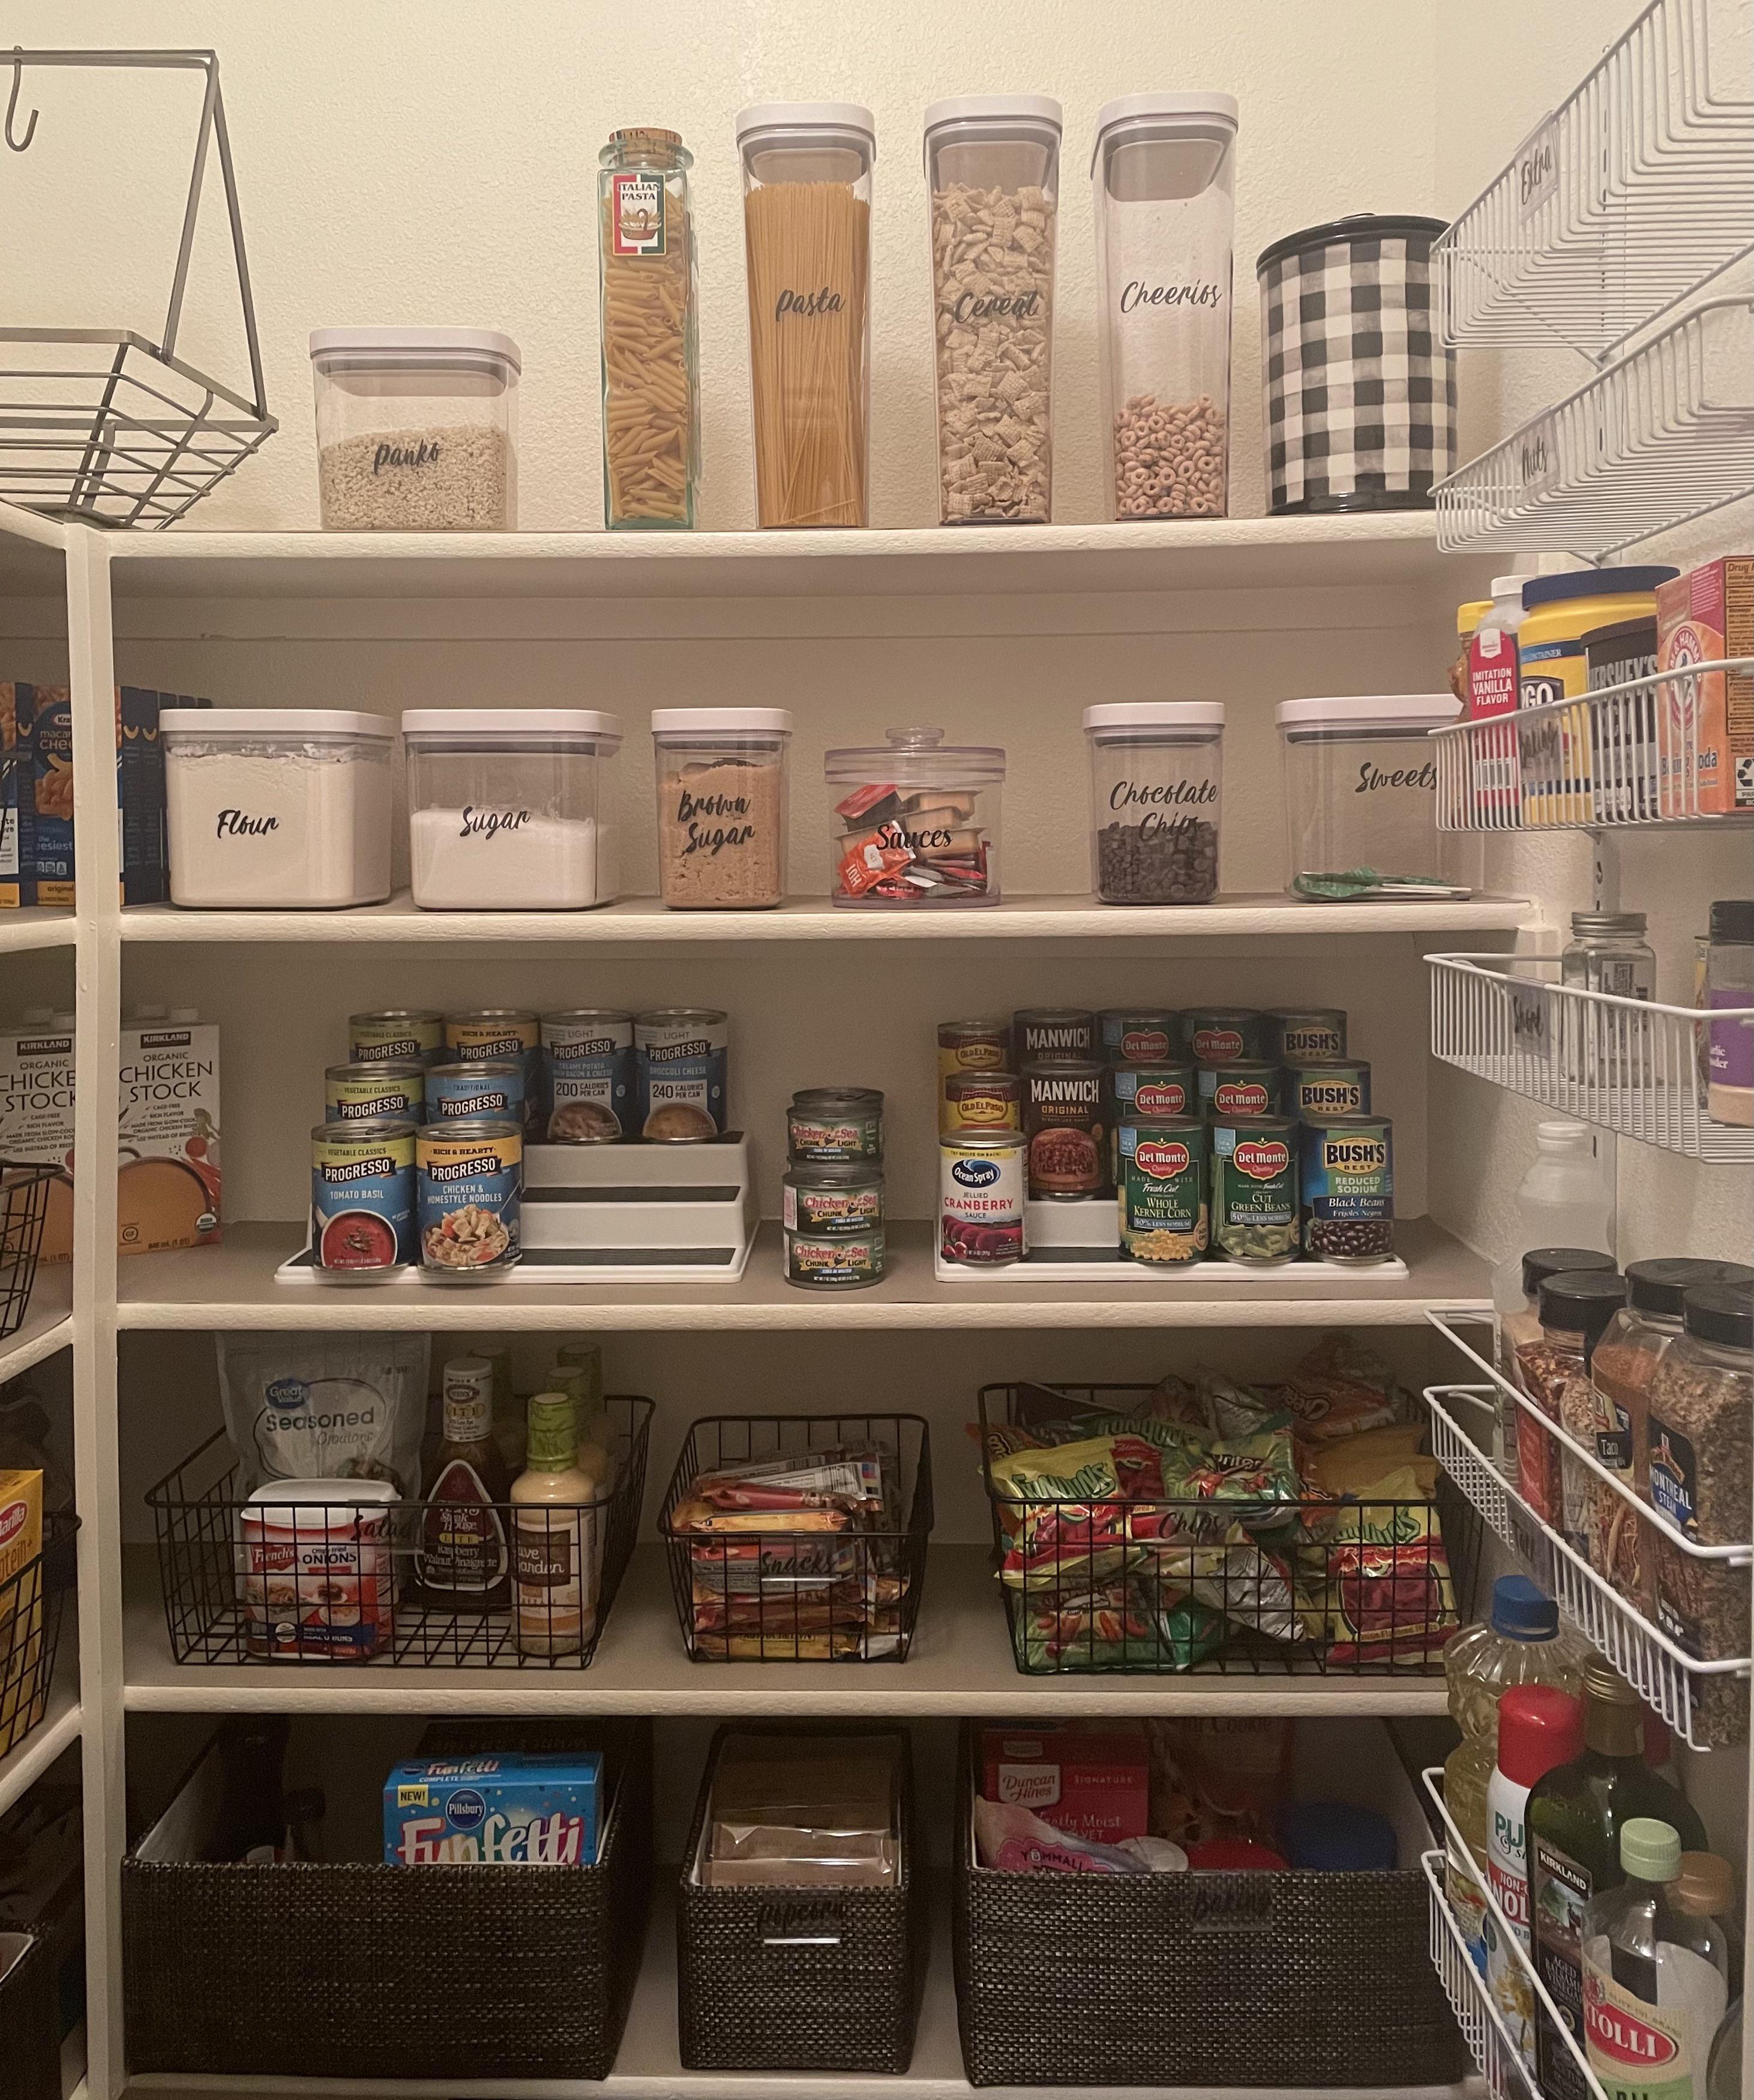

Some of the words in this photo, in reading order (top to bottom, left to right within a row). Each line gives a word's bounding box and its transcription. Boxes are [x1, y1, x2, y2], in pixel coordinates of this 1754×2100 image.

[1521, 145, 1552, 205] Extra
[617, 183, 660, 191] ITALIAN
[1121, 279, 1222, 313] Cheerios
[955, 290, 1039, 323] Cereal
[1728, 563, 1749, 574] Drug
[1473, 667, 1512, 682] IMITATION
[1473, 681, 1513, 695] VANILLA
[1476, 694, 1509, 706] FLAVOR
[1521, 683, 1554, 708] GO
[40, 730, 71, 739] macar
[1355, 762, 1439, 793] Sweets
[1110, 779, 1218, 810] Chocolate
[678, 790, 751, 822] Brown
[217, 809, 279, 839] Flour
[460, 806, 531, 840] Sugar
[1139, 811, 1201, 840] Chips
[685, 822, 756, 856] Sugar
[877, 824, 954, 850] Sauces
[845, 864, 862, 887] HOT
[20, 1040, 69, 1050] KIRKLAND
[143, 1033, 189, 1043] KIRKLAND
[1026, 1027, 1090, 1051] MANWICH
[1125, 1040, 1139, 1050] Del
[1141, 1040, 1167, 1050] Monte
[1196, 1040, 1209, 1050] Del
[1211, 1040, 1240, 1050] Monte
[1286, 1033, 1339, 1051] BUSH'S
[143, 1052, 189, 1062] ORGANIC
[358, 1042, 415, 1060] PROGRESSO
[461, 1040, 517, 1060] PROGRESSO
[554, 1040, 610, 1060] PROGRESSO
[649, 1042, 706, 1061] PROGRESSO
[20, 1059, 68, 1070] ORGANIC
[120, 1060, 212, 1083] CHICKEN
[649, 1067, 680, 1075] BROCCOLI
[682, 1066, 706, 1075] CHEESE
[0, 1070, 76, 1091] CHICKE
[130, 1081, 201, 1102] STOCK
[556, 1083, 577, 1096] 200
[653, 1085, 673, 1098] 240
[1031, 1079, 1099, 1103] MANWICH
[1302, 1086, 1359, 1106] BUSH'S
[5, 1091, 75, 1112] STOCK
[442, 1094, 503, 1115] PROGRESSO
[1139, 1094, 1155, 1104] Del
[1156, 1094, 1183, 1104] Monte
[1219, 1094, 1234, 1104] Del
[1236, 1094, 1265, 1105] Monte
[341, 1096, 403, 1117] PROGRESSO
[962, 1103, 975, 1111] OLD
[1042, 1105, 1089, 1114] ORIGINAL
[792, 1126, 825, 1139] Chicken
[841, 1129, 857, 1138] Sea
[328, 1148, 356, 1156] VEGETABLE
[358, 1147, 386, 1156] CLASSICS
[1139, 1151, 1154, 1163] Del
[1156, 1153, 1186, 1163] Monte
[1239, 1152, 1254, 1163] Del
[1257, 1153, 1285, 1163] Monte
[1327, 1144, 1385, 1165] BUSH'S
[325, 1159, 389, 1181] PROGRESSO
[431, 1157, 496, 1181] PROGRESSO
[955, 1167, 973, 1182] Ocean
[974, 1169, 994, 1184] Spray
[1143, 1183, 1163, 1192] Fresh
[1164, 1184, 1179, 1193] Cut
[1335, 1177, 1380, 1186] REDUCED
[331, 1190, 359, 1200] TOMATO
[361, 1190, 383, 1199] BASIL
[443, 1185, 476, 1194] CHICKEN
[478, 1184, 484, 1193] &
[1337, 1185, 1378, 1194] SODIUM
[427, 1195, 467, 1205] HOMESTYLE
[469, 1193, 502, 1202] NOODLES
[805, 1197, 847, 1209] Chicken
[945, 1197, 1014, 1210] CRANBERRY
[1147, 1198, 1178, 1208] WHOLE
[1252, 1194, 1273, 1203] CUT
[1329, 1198, 1357, 1207] Black
[1359, 1198, 1385, 1207] Beans
[1134, 1205, 1166, 1218] KERNEL
[1167, 1208, 1191, 1218] CORN
[1231, 1201, 1263, 1211] GREEN
[1265, 1203, 1290, 1211] BEANS
[1135, 1218, 1151, 1226] 50%
[795, 1245, 835, 1259] Chicken
[851, 1247, 868, 1258] Sea
[270, 1387, 302, 1397] Great
[277, 1395, 302, 1403] Value
[266, 1406, 374, 1432] Seasoned
[1601, 1439, 1618, 1455] Taco
[440, 1512, 468, 1522] Stak
[254, 1547, 294, 1563] French's
[302, 1553, 357, 1564] ONIONS
[518, 1560, 565, 1574] arden
[427, 1759, 500, 1775] Funfetti
[1002, 1774, 1056, 1791] Duncan
[1074, 1775, 1133, 1784] SIGNATURE
[400, 1791, 425, 1801] NEW!
[1010, 1786, 1053, 1801] Hines
[449, 1803, 484, 1817] Pillsbury
[1081, 1814, 1122, 1828] Moist
[1495, 1811, 1524, 1848] PU
[397, 1812, 580, 1864] Funfetti
[1540, 1850, 1586, 1890] KIRKLAND
[1501, 1873, 1528, 1897] NON-
[1590, 2003, 1656, 2058] TOLLI
